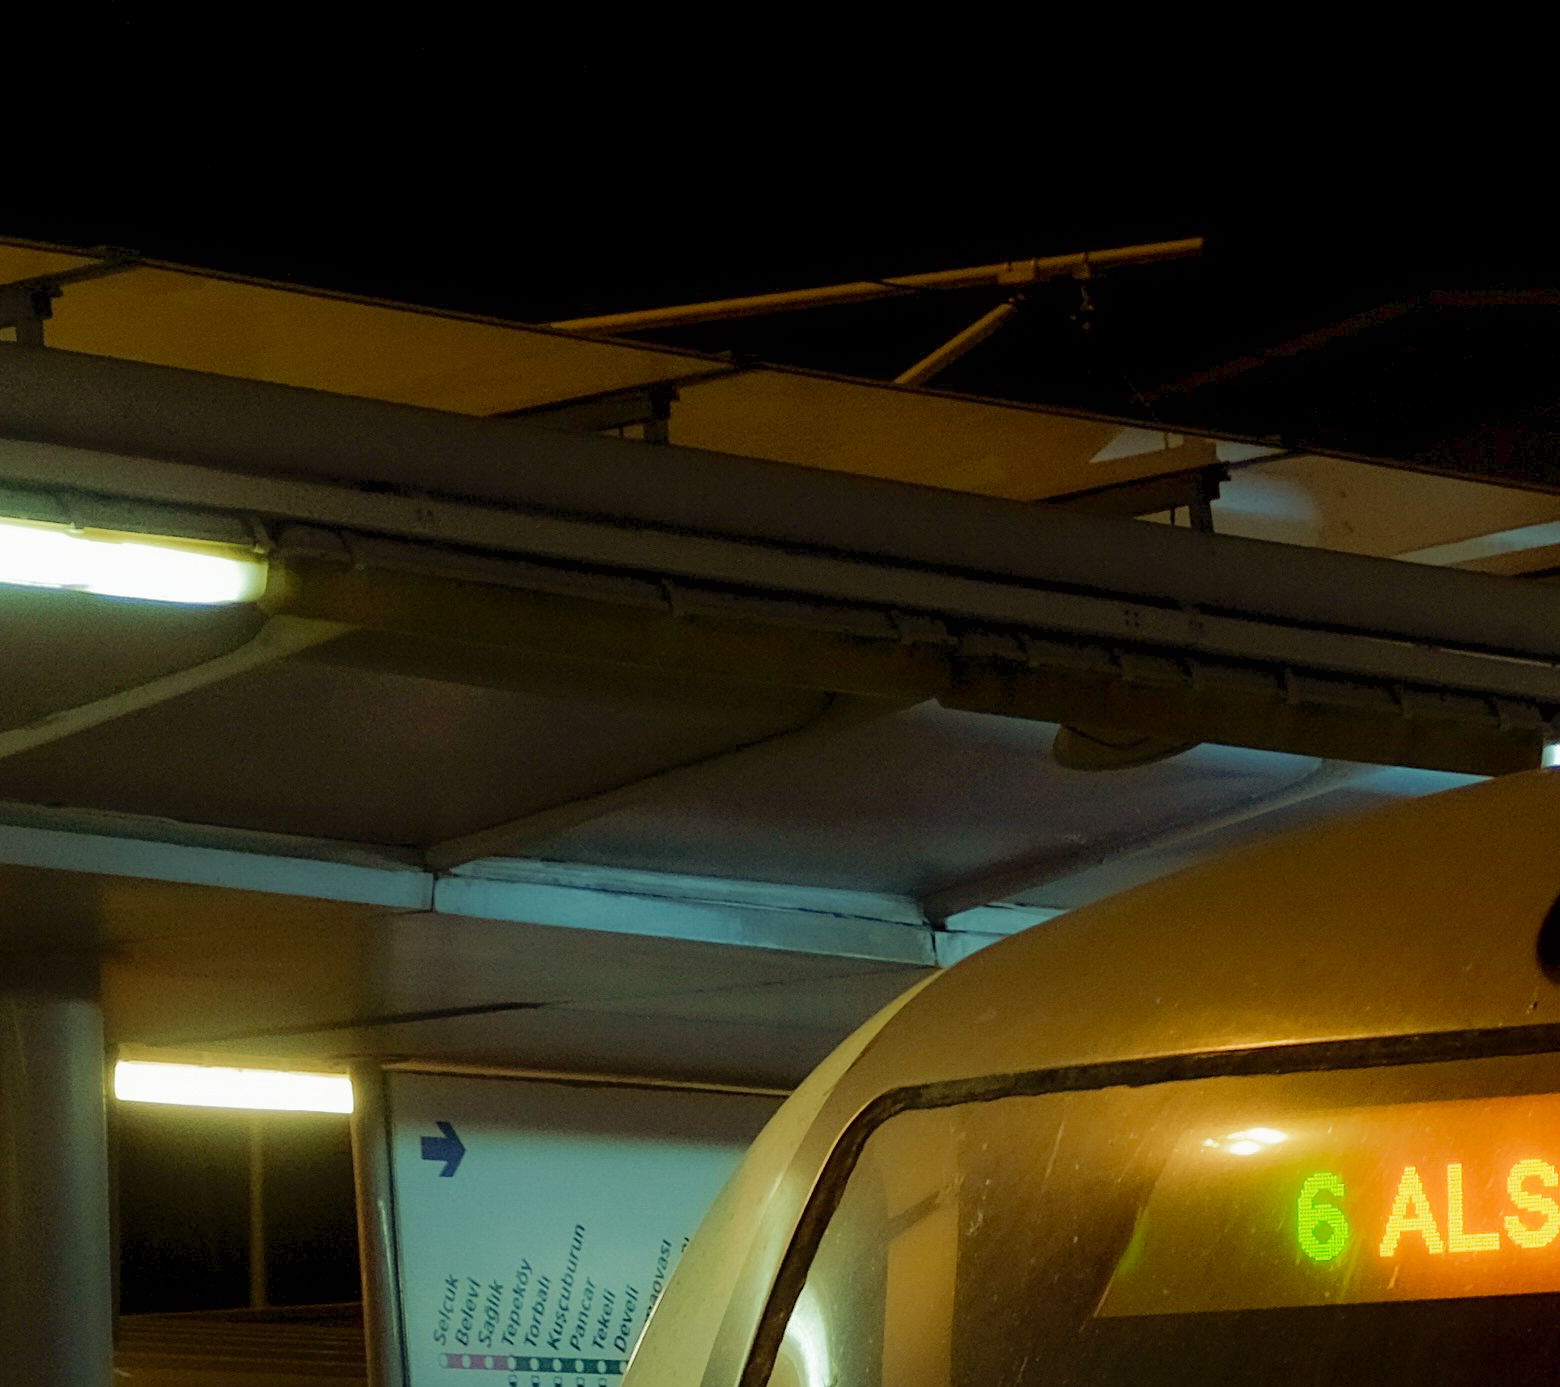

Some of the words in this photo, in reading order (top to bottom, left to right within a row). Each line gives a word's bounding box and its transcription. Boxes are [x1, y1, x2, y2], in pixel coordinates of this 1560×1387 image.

[1296, 1172, 1346, 1261] 6
[433, 1273, 459, 1347] Selçuk
[455, 1276, 481, 1347] Belevi
[569, 1276, 596, 1352] Pancar
[592, 1287, 616, 1349] Tekeli
[614, 1283, 639, 1354] Develi
